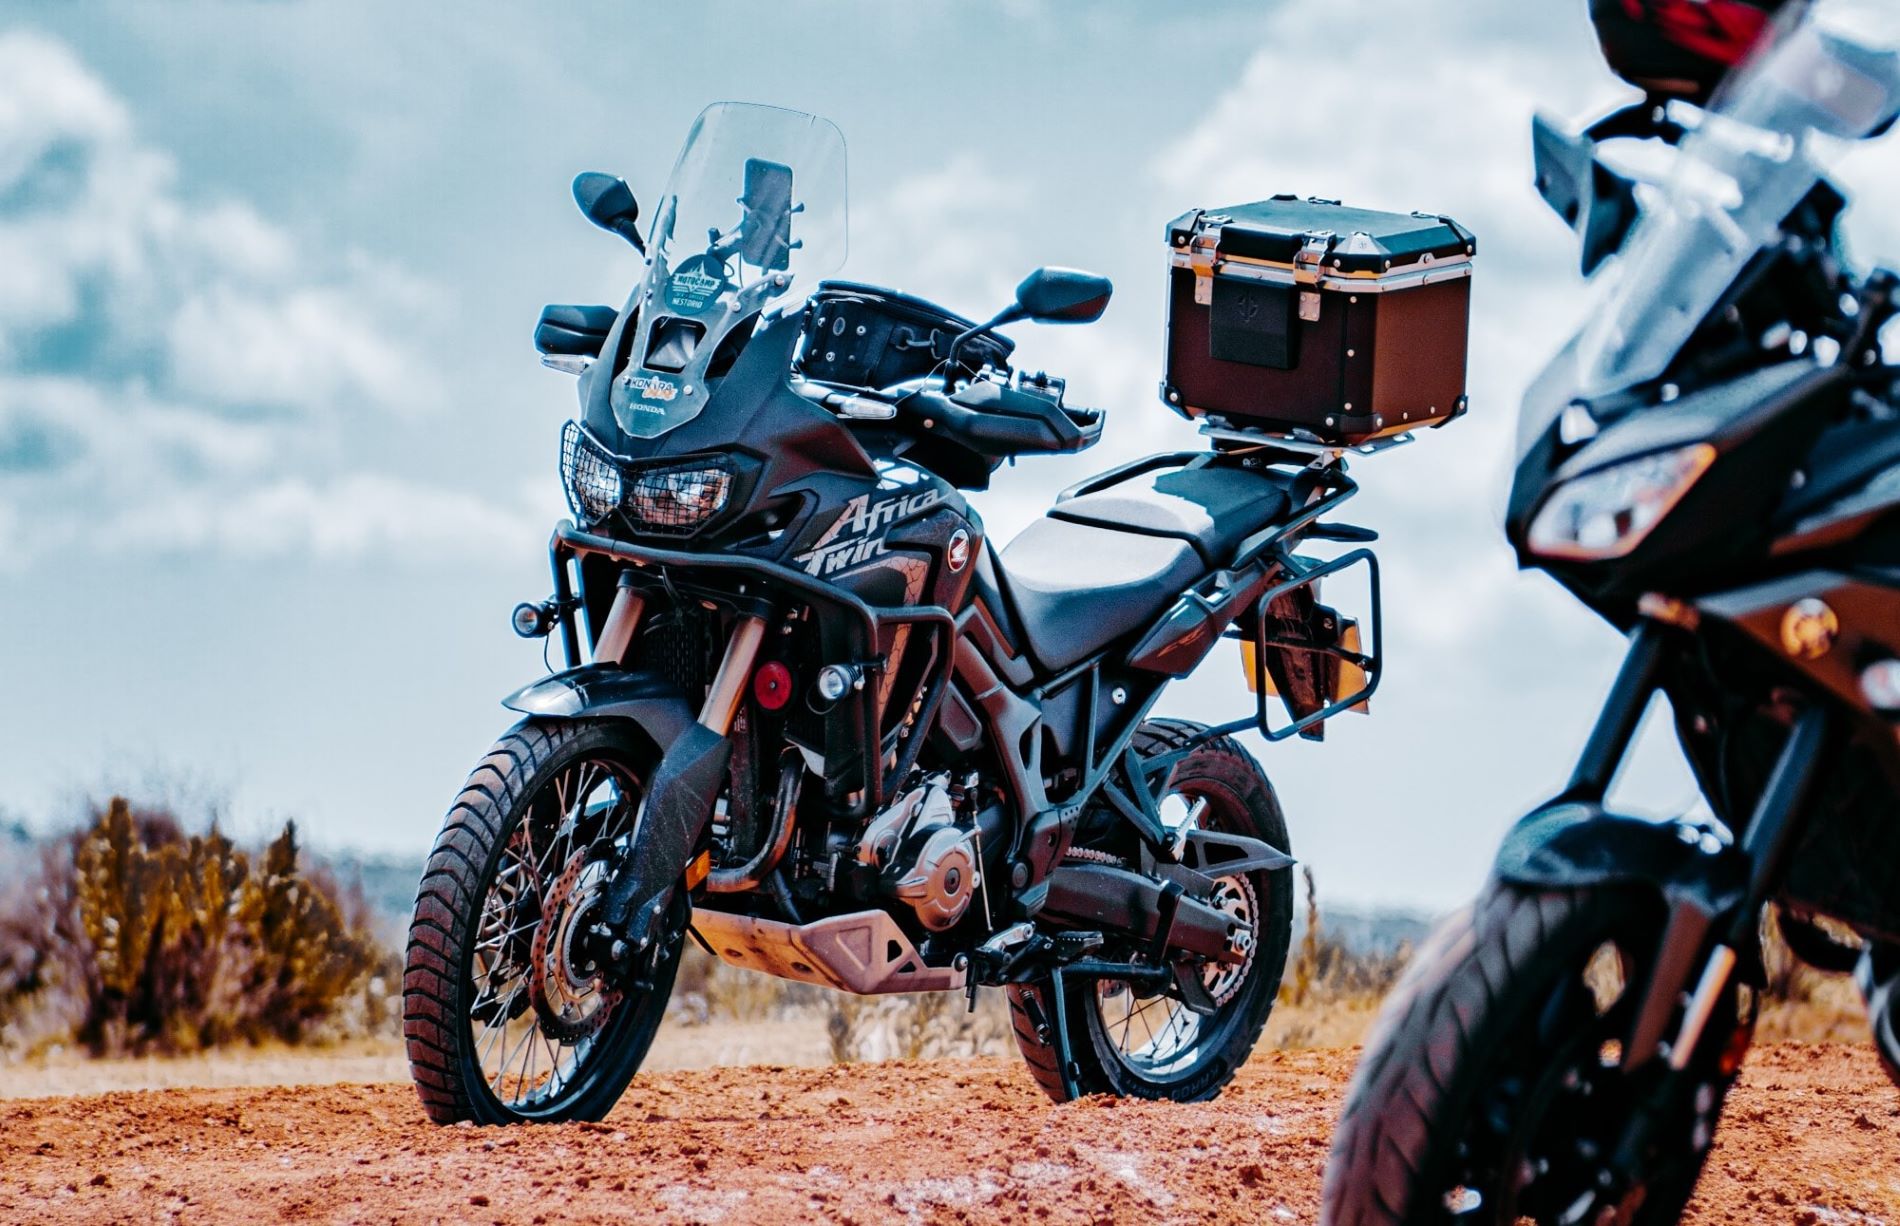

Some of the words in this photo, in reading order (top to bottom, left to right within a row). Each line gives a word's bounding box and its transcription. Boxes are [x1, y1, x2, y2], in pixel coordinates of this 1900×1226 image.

[676, 275, 716, 288] MOTOCAMP
[630, 403, 665, 416] HONDA
[811, 488, 943, 551] Africa
[793, 536, 893, 577] Twin
